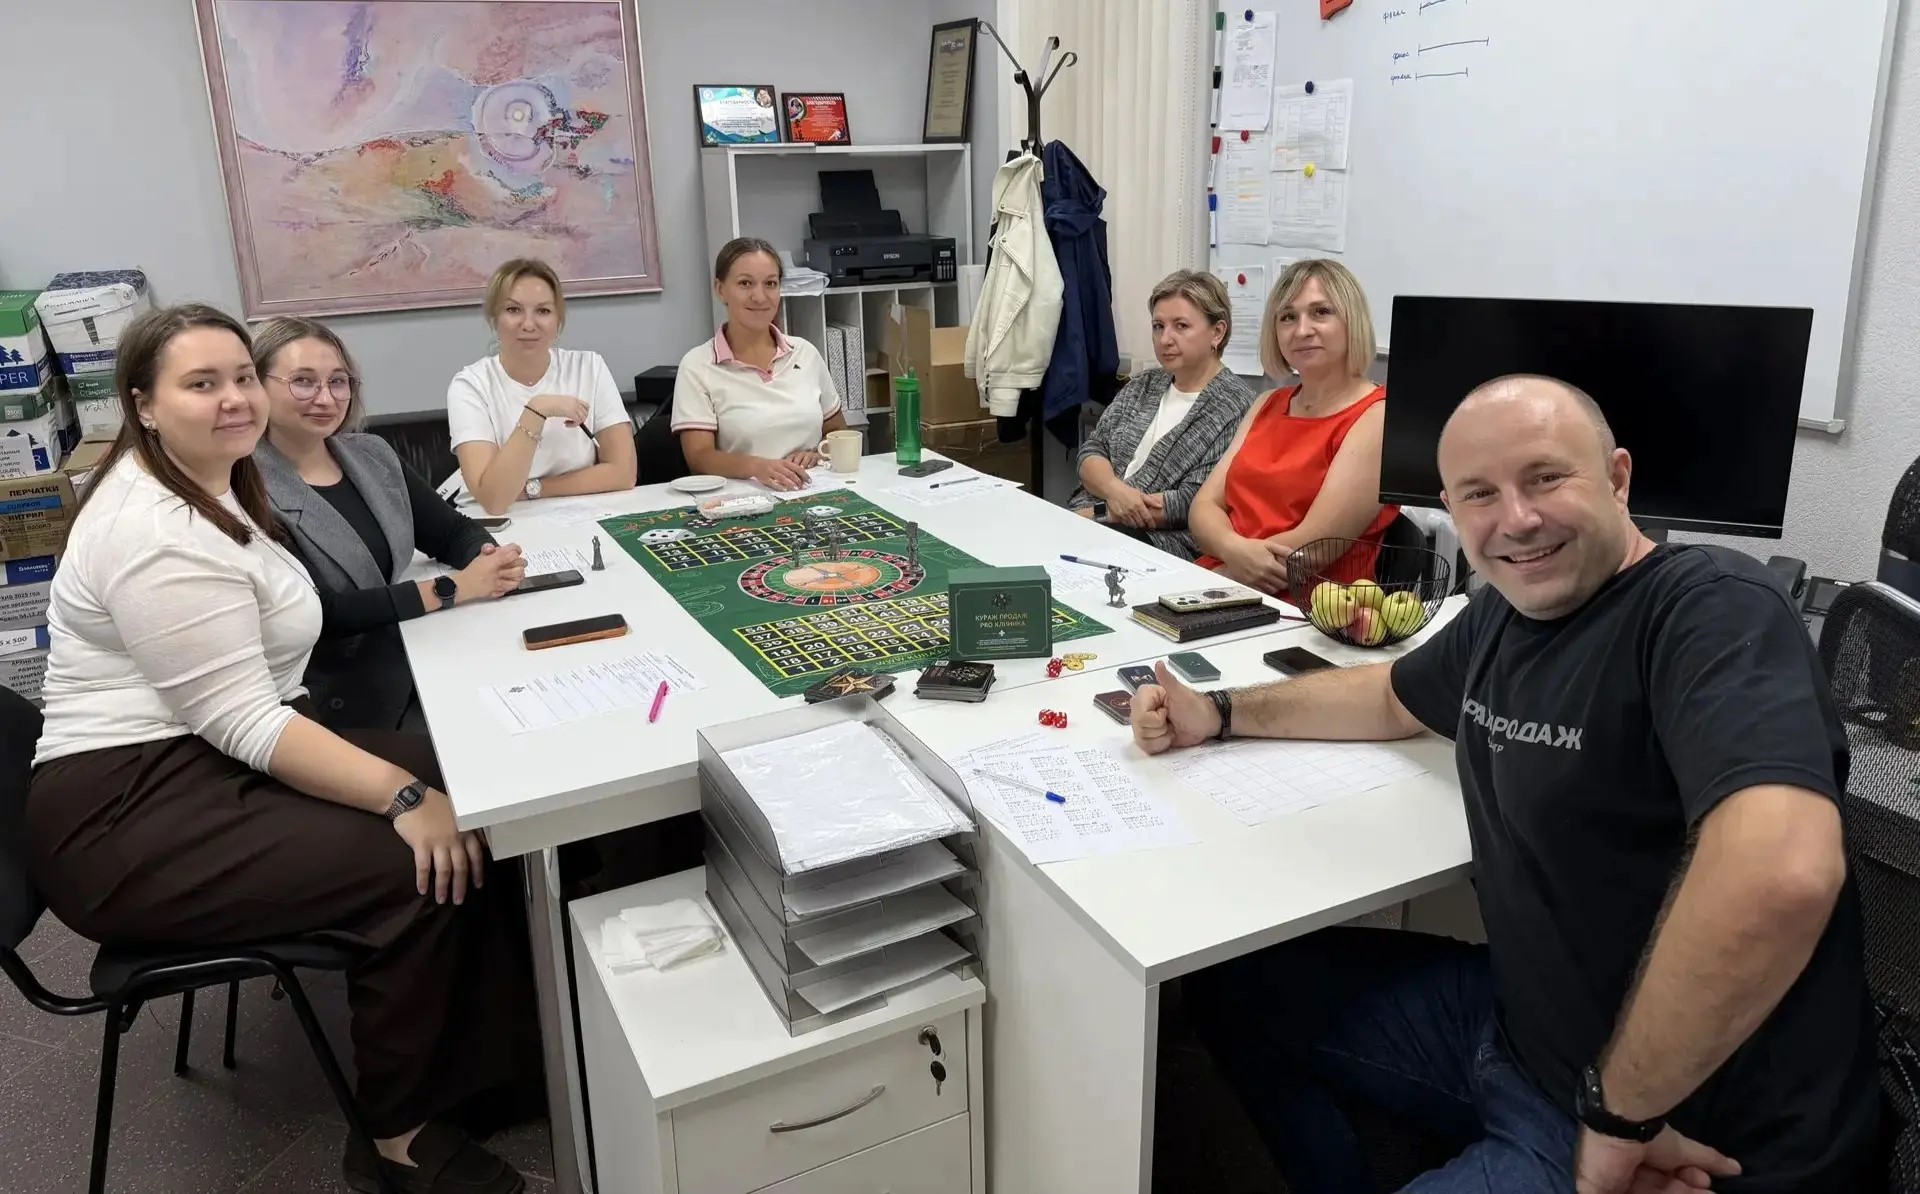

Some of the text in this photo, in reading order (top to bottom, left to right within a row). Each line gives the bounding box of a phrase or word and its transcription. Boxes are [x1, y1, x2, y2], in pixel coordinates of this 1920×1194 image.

[9, 485, 59, 497] ПЕРЧАТКИ
[7, 501, 41, 510] ГОЛУБОЙ
[8, 511, 44, 521] НИТРИЛ
[657, 542, 677, 550] 24
[745, 626, 766, 634] 54
[776, 620, 797, 628] 53
[809, 614, 828, 622] 52
[868, 603, 888, 611] 50
[975, 612, 1028, 621] КУРАЖ ПРОДАЖ
[752, 633, 772, 641] 37
[784, 627, 806, 635] 38
[817, 621, 838, 629] 39
[850, 615, 869, 623] 40
[771, 618, 950, 657] 19 20 21 22 23 24
[761, 640, 783, 648] 36
[780, 657, 802, 666] 18
[813, 650, 832, 659] 17
[847, 644, 869, 652] 16
[910, 632, 931, 640] 14
[829, 657, 843, 665] 2
